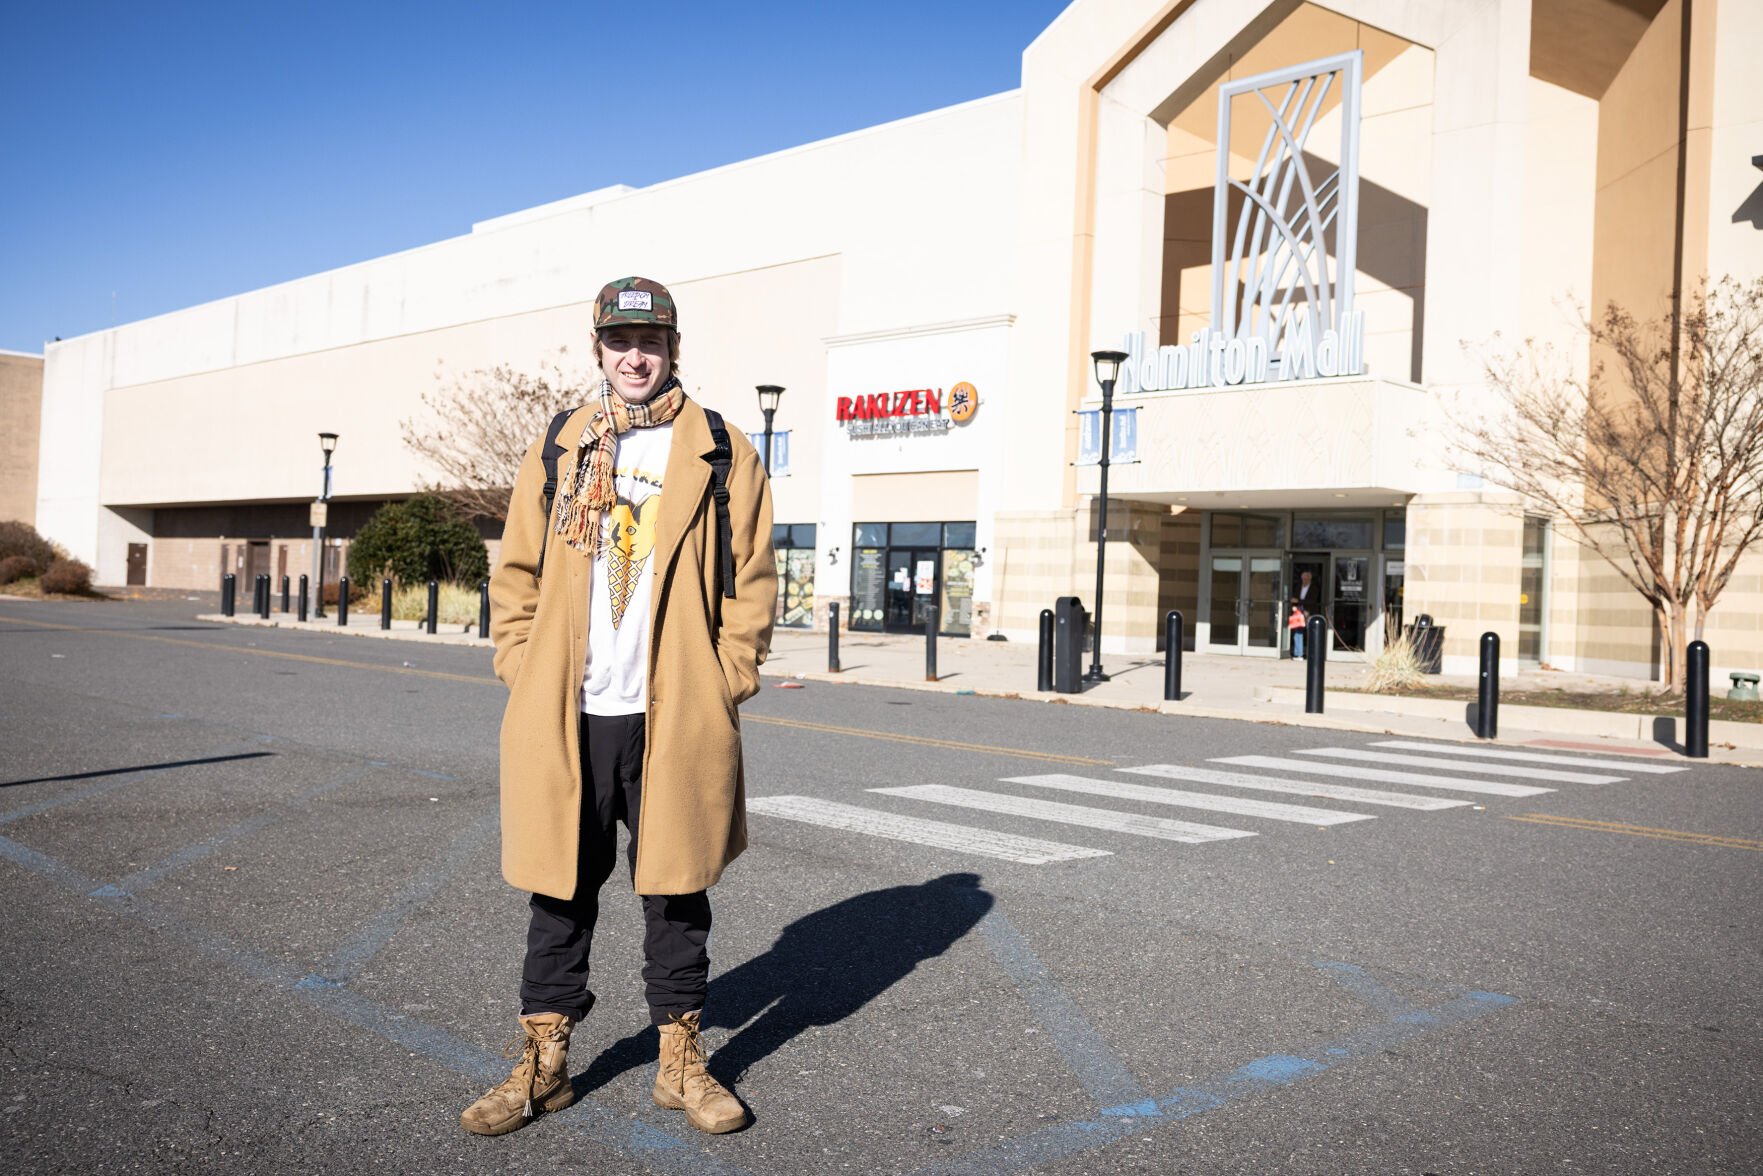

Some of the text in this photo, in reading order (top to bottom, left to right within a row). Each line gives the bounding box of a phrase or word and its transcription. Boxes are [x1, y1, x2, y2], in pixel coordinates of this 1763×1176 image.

[1121, 307, 1364, 393] Hamilton Mall
[836, 388, 942, 420] RAKUZEN
